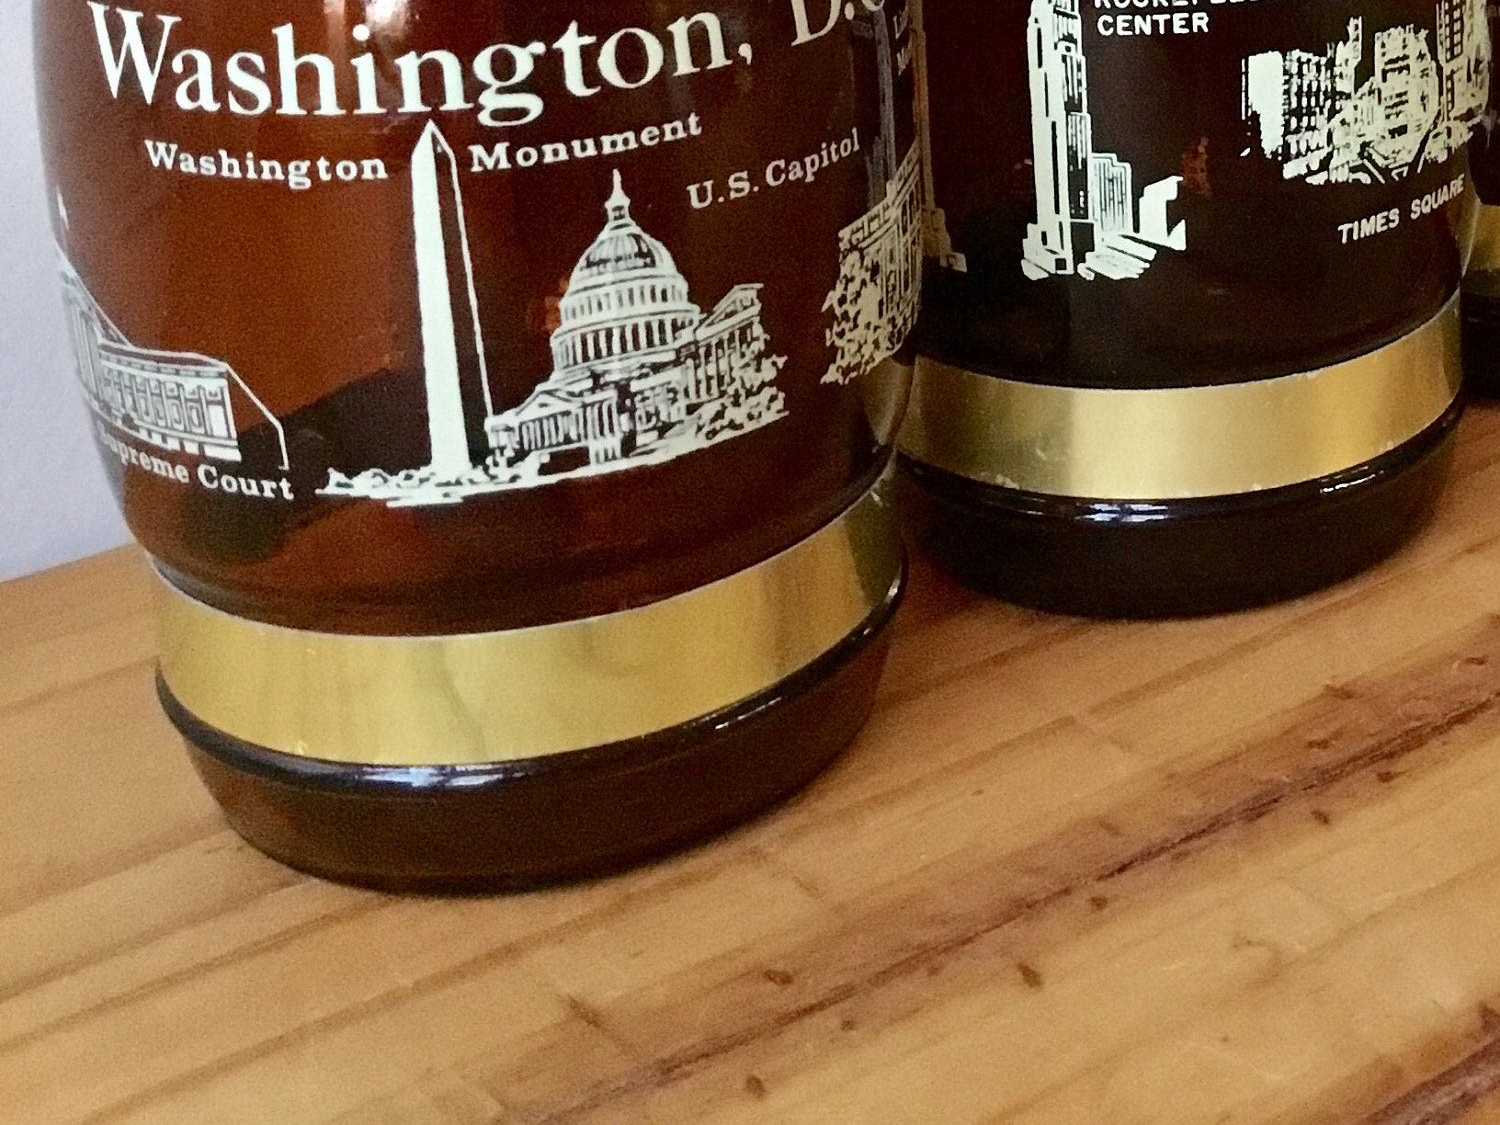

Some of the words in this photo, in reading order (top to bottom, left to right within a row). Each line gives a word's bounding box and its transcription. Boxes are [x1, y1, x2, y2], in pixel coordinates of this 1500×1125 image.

[1098, 13, 1209, 36] CENTER
[87, 0, 753, 127] Washington,
[144, 140, 388, 189] Washington
[467, 112, 702, 173] Monument
[687, 172, 759, 209] U.S.
[766, 128, 861, 187] Capitol
[1338, 208, 1399, 244] TIMES
[1410, 174, 1465, 220] SQUARE
[197, 463, 295, 501] Court
